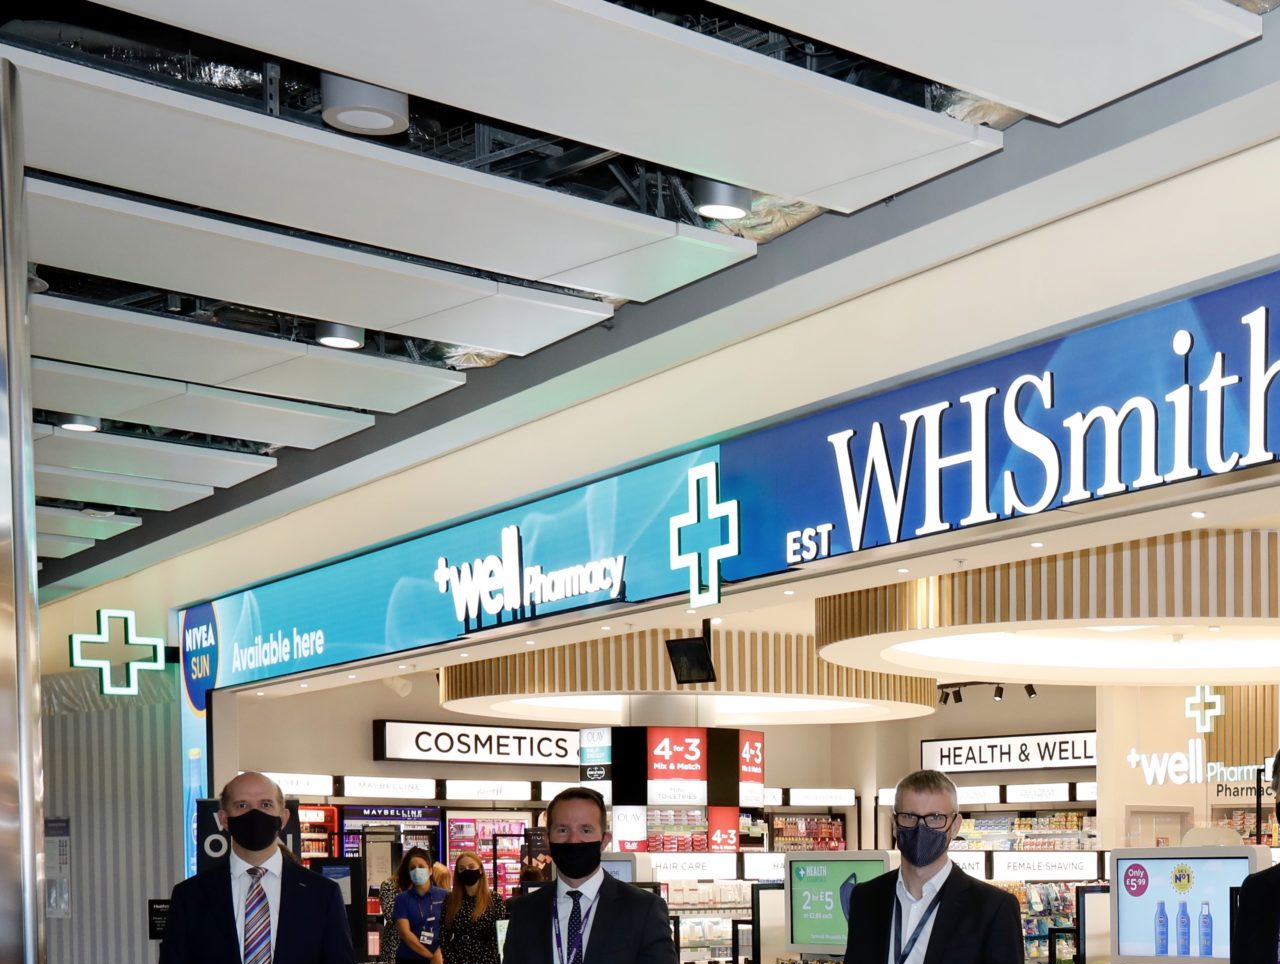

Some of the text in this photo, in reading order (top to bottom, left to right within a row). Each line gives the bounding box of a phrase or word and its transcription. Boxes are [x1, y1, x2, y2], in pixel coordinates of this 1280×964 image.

[786, 523, 833, 563] EST
[523, 554, 626, 606] Pharmacy
[185, 622, 215, 652] NIVEA
[232, 627, 324, 672] Available here
[191, 654, 210, 680] SUN
[415, 731, 568, 758] COSMETICS
[653, 737, 700, 760] 4 for 3
[741, 741, 750, 763] 4
[754, 742, 762, 764] 3
[939, 744, 1011, 765] HEALTH
[1018, 743, 1030, 762] &
[653, 762, 667, 770] Mix
[676, 763, 701, 771] Match
[1140, 737, 1203, 785] well
[1216, 784, 1273, 797] Pharmac
[363, 808, 423, 817] MAYBELLINE
[711, 829, 722, 844] 4
[727, 829, 737, 844] 3
[655, 863, 708, 871] HAIR CARE
[806, 866, 827, 876] HEALTH
[1006, 860, 1084, 872] FEMALE SHAVING
[1128, 869, 1144, 879] Only
[1126, 878, 1146, 890] £5.99
[802, 891, 811, 911] 2
